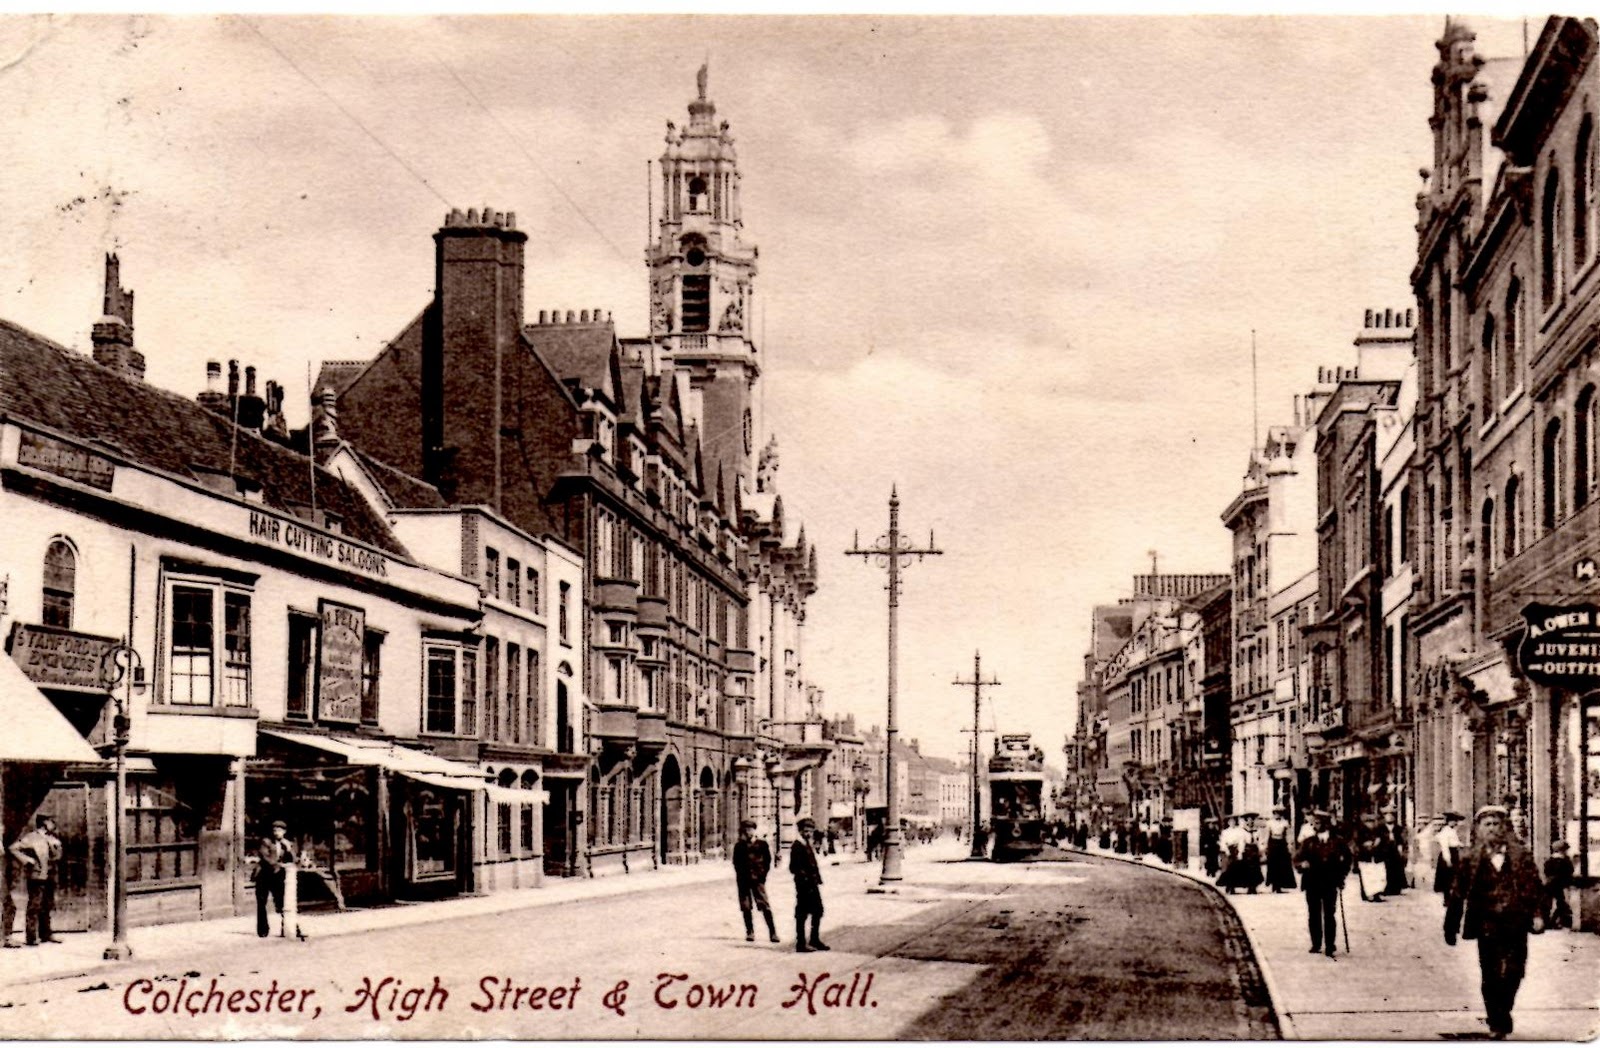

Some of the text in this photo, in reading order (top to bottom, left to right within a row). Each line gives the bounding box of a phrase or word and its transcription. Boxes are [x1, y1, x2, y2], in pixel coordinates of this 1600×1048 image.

[250, 511, 280, 543] HAIR
[285, 524, 334, 559] CUTTING
[1534, 643, 1600, 656] JUVENI
